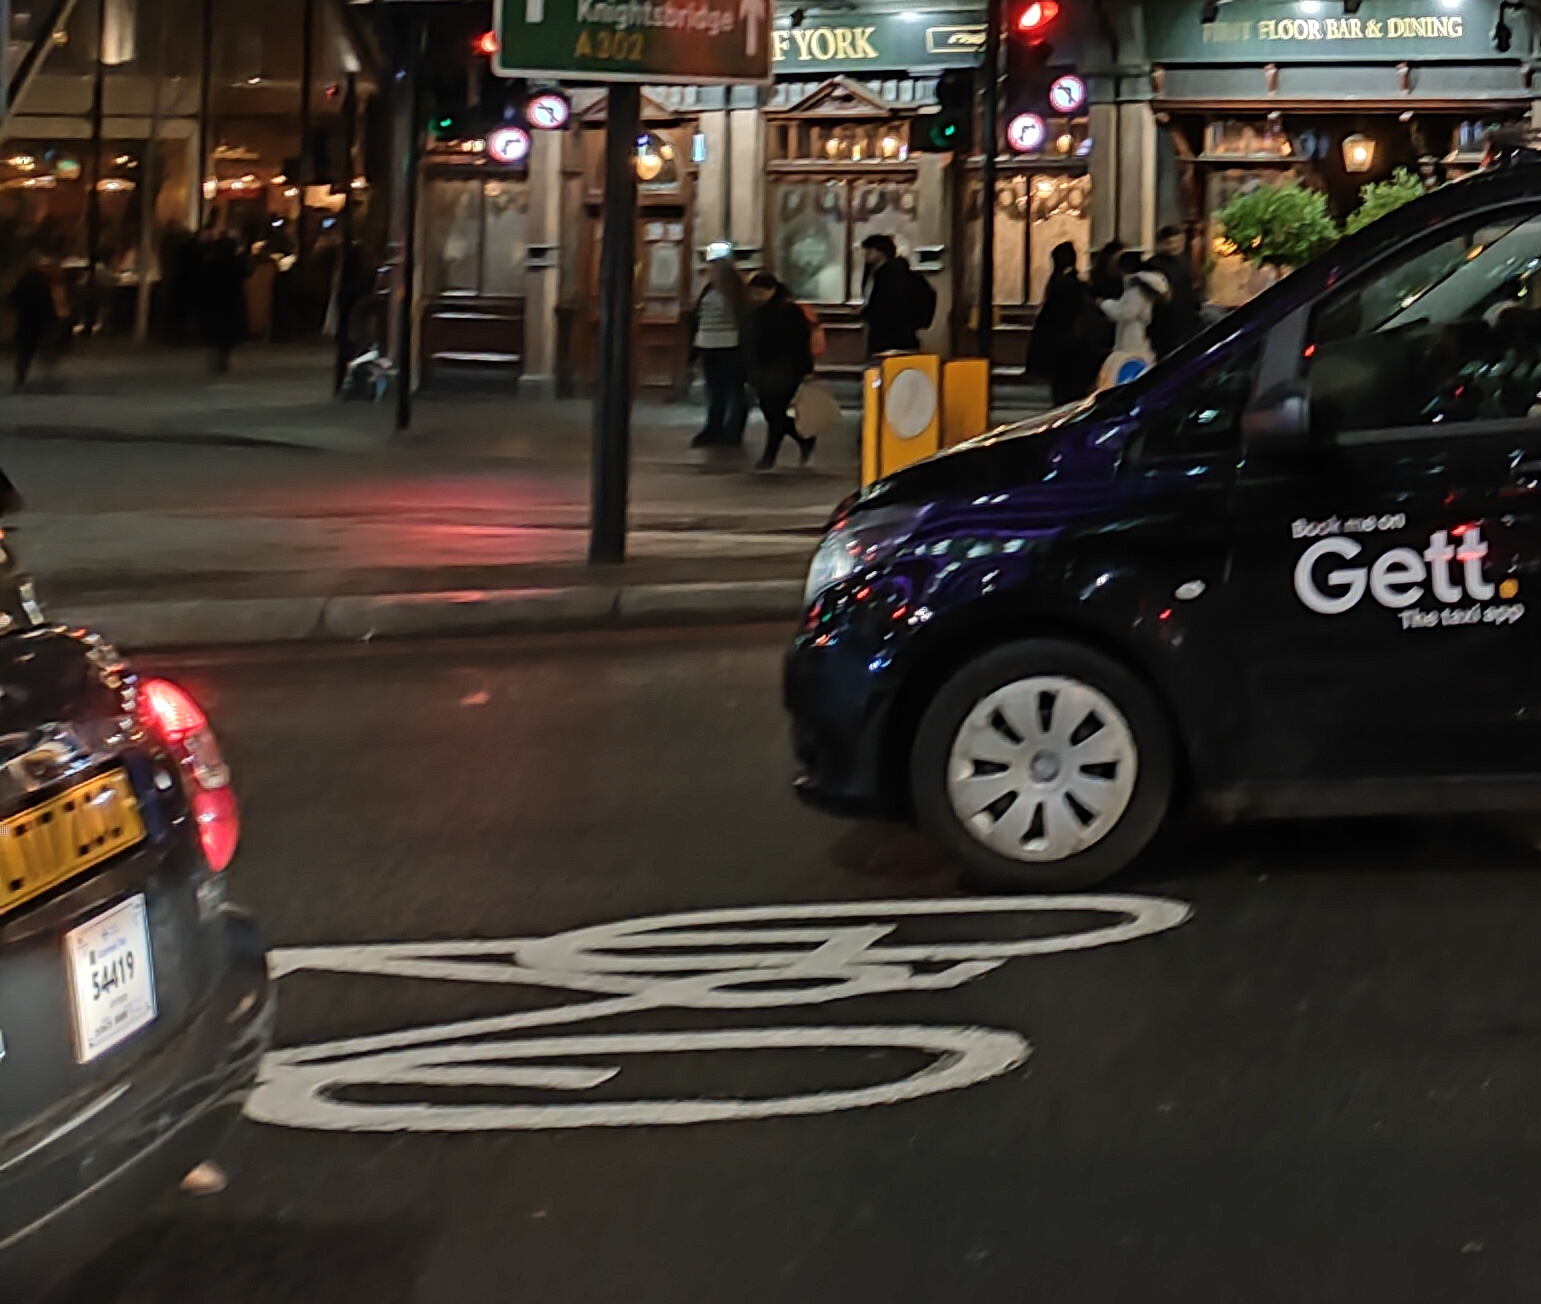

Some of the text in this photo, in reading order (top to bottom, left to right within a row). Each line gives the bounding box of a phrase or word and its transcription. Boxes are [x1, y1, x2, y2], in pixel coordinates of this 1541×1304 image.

[1257, 18, 1323, 40] FLOOR
[1325, 17, 1364, 39] BAR
[1365, 19, 1384, 39] &
[1387, 16, 1463, 39] DINING
[770, 26, 879, 61] F YORK
[1291, 515, 1341, 539] Book
[1398, 602, 1525, 630] The taxi app
[91, 950, 135, 1001] 54419
